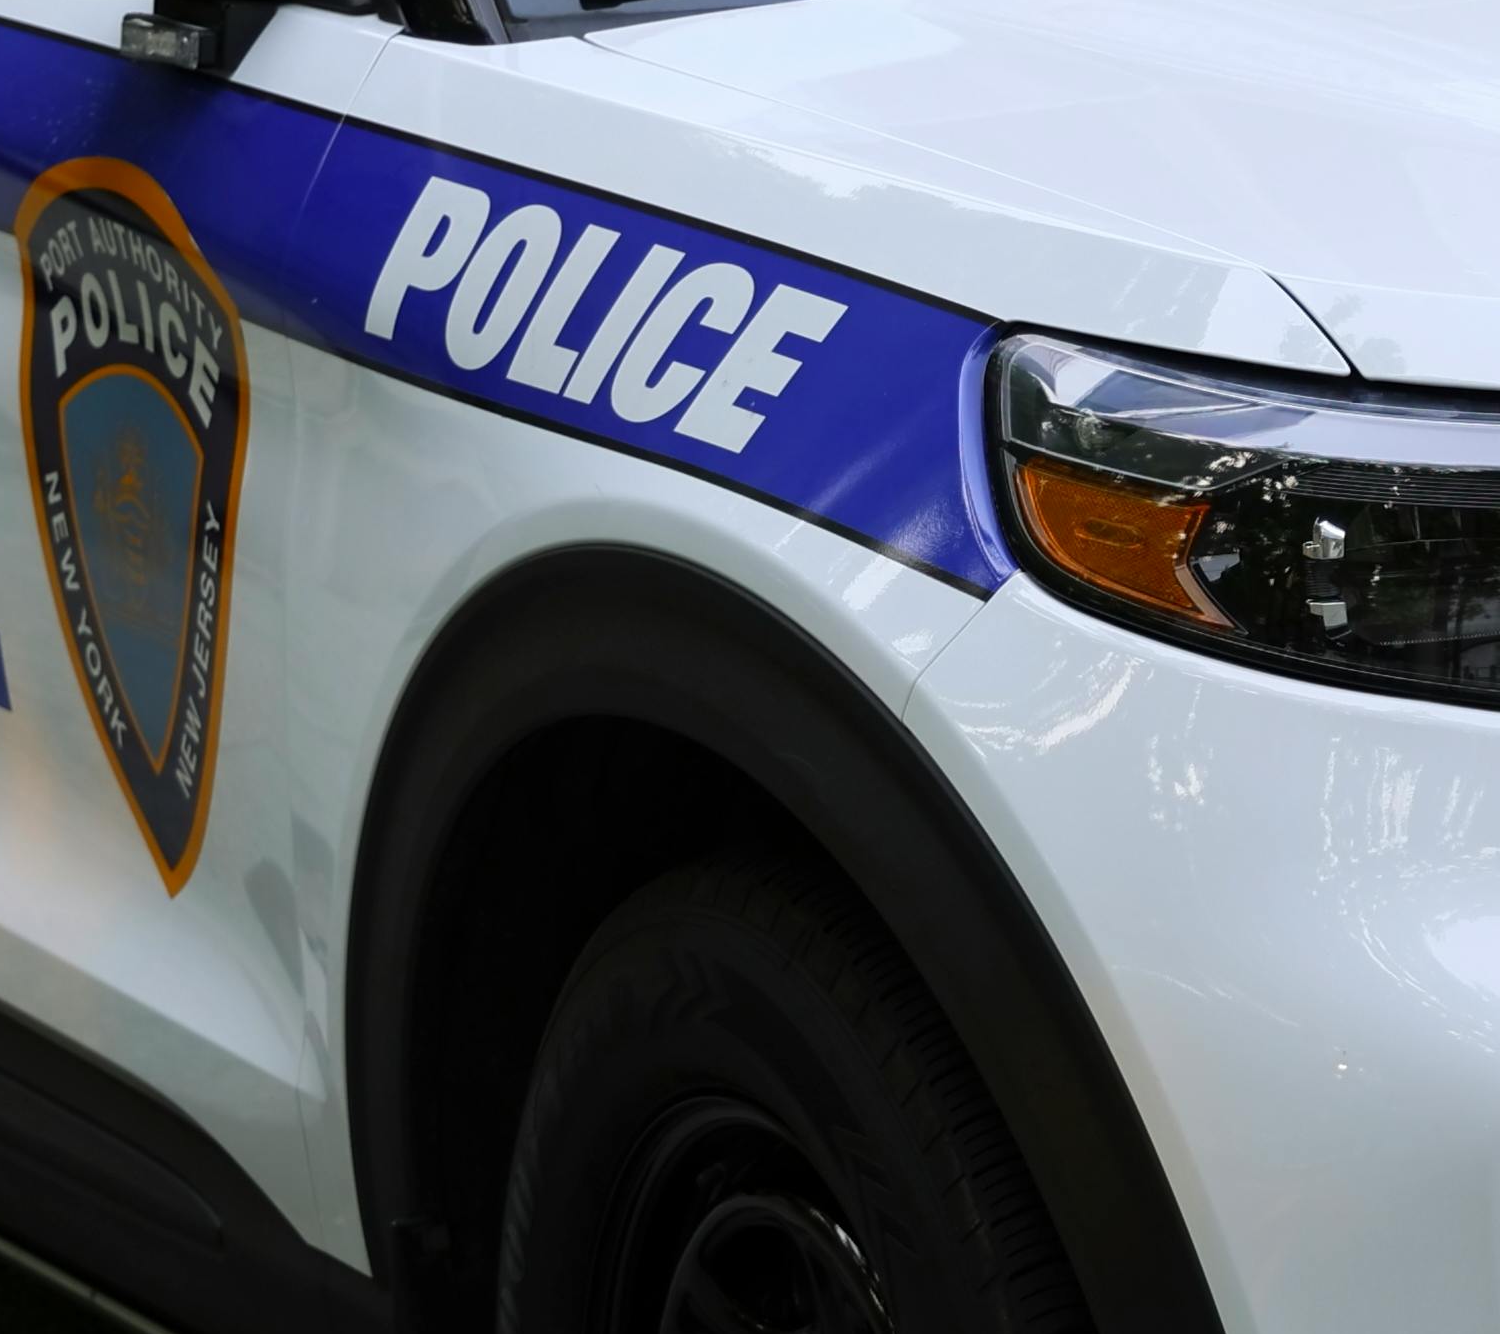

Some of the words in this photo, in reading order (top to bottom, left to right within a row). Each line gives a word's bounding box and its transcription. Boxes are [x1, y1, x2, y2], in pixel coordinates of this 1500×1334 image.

[39, 220, 84, 292] PORT
[88, 216, 223, 350] AUTHORITY
[50, 269, 221, 430] POLICE
[363, 175, 849, 455] POLICE
[44, 470, 80, 591] NEW
[77, 607, 128, 748] YORK
[174, 695, 203, 799] NEW
[191, 500, 221, 698] JERSEY
